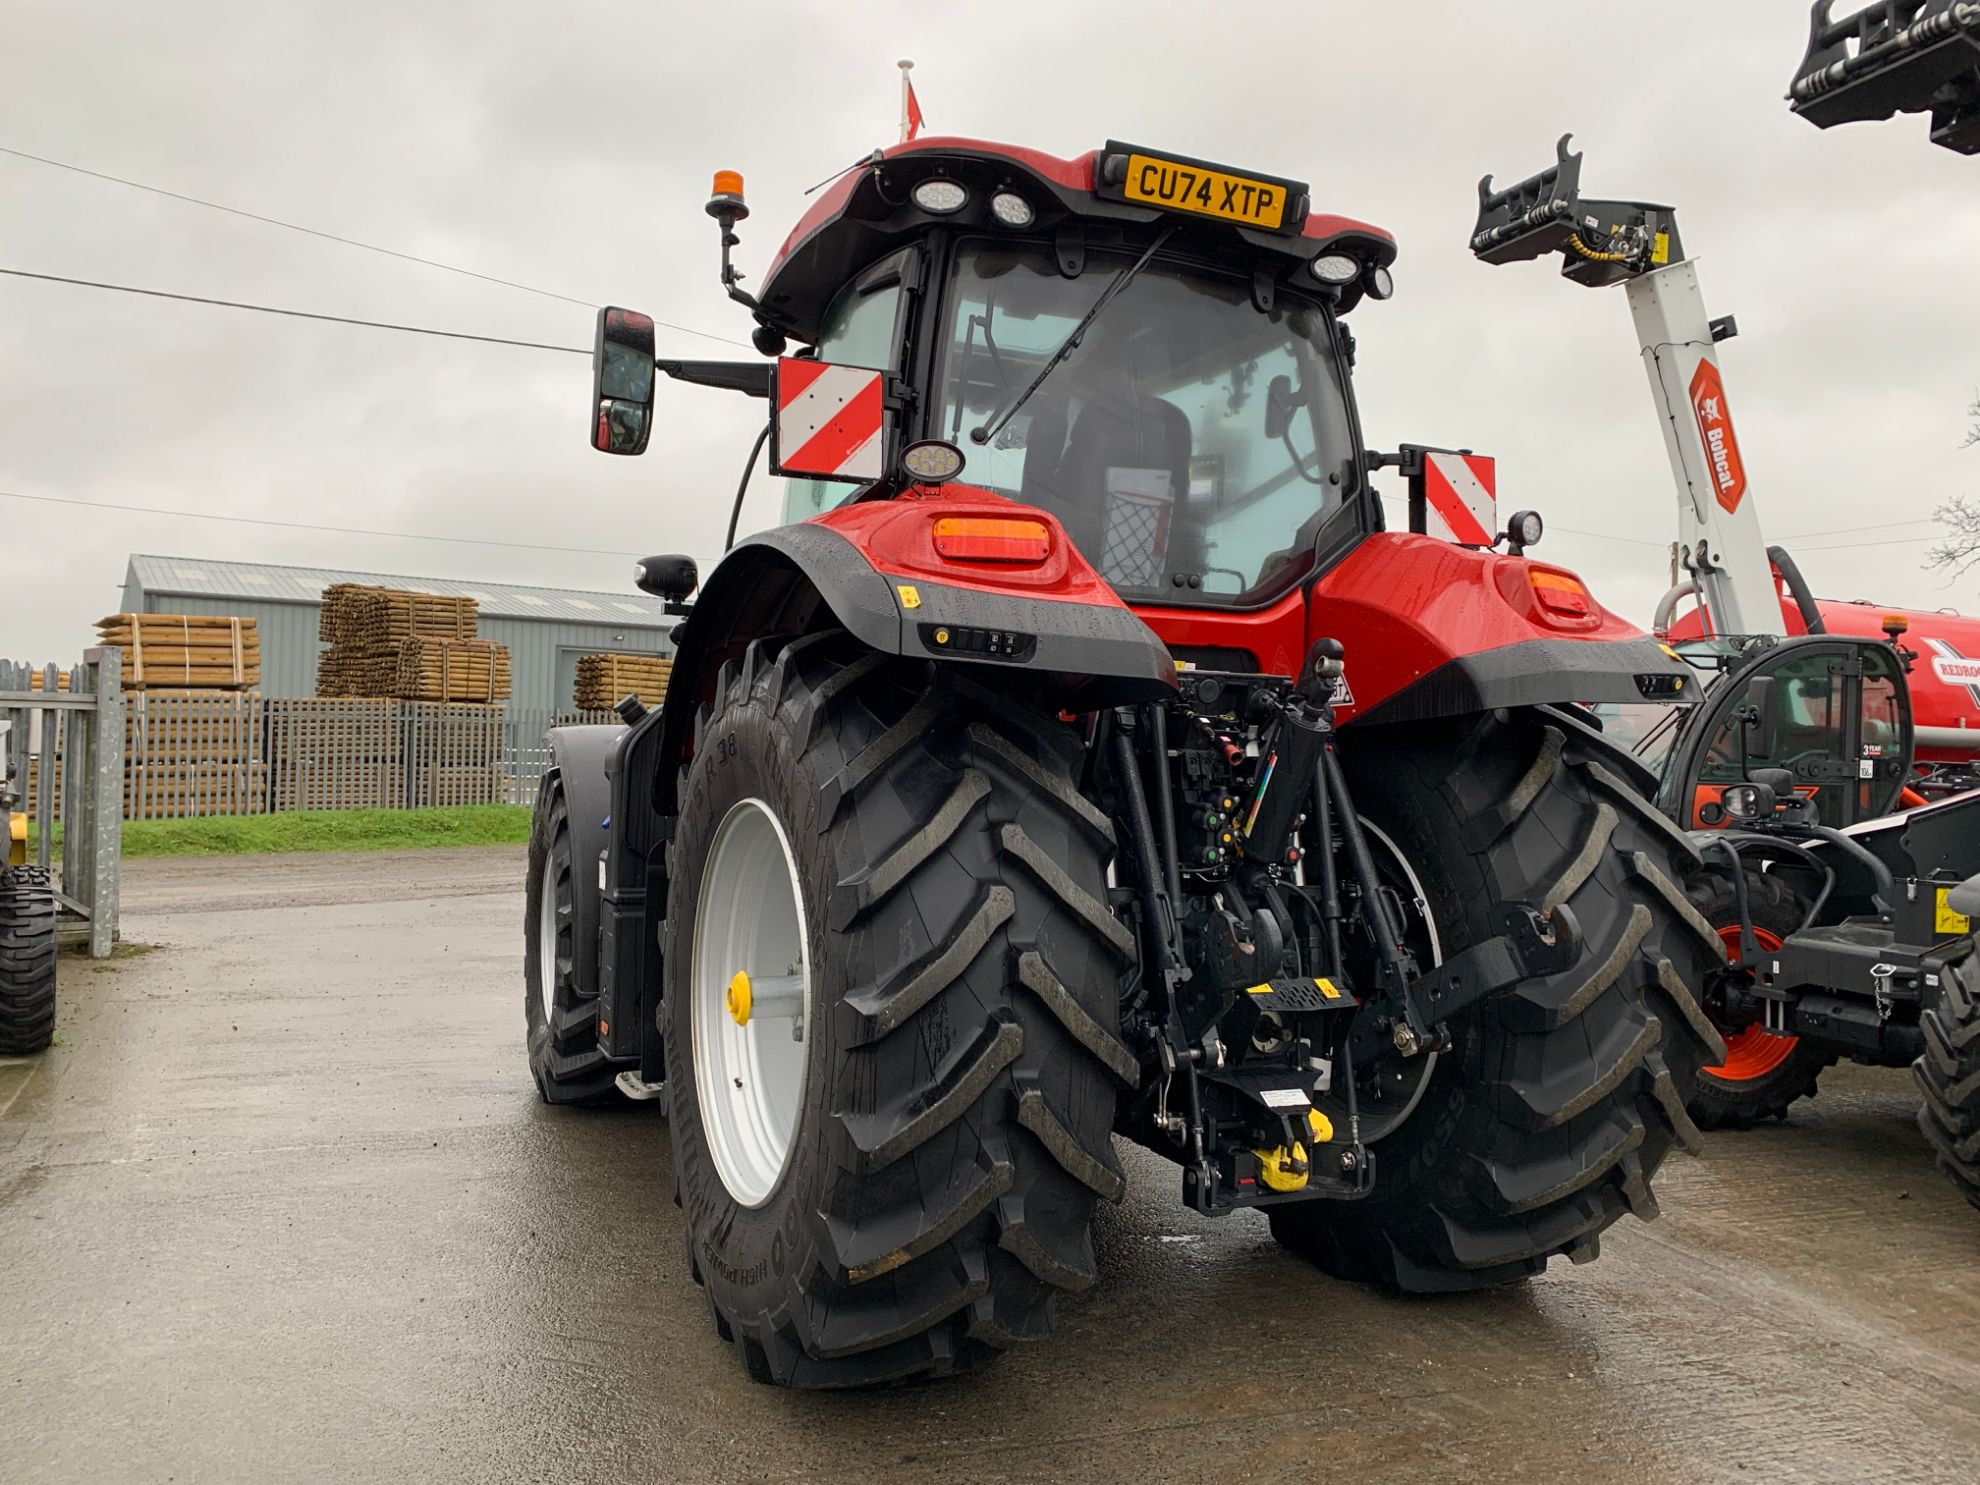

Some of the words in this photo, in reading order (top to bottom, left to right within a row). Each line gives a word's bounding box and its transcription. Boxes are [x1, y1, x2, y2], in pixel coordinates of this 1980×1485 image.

[1139, 165, 1212, 208] CU74
[1219, 181, 1274, 218] XTP
[1707, 427, 1735, 490] Bobcat
[740, 1259, 767, 1288] HIGH
